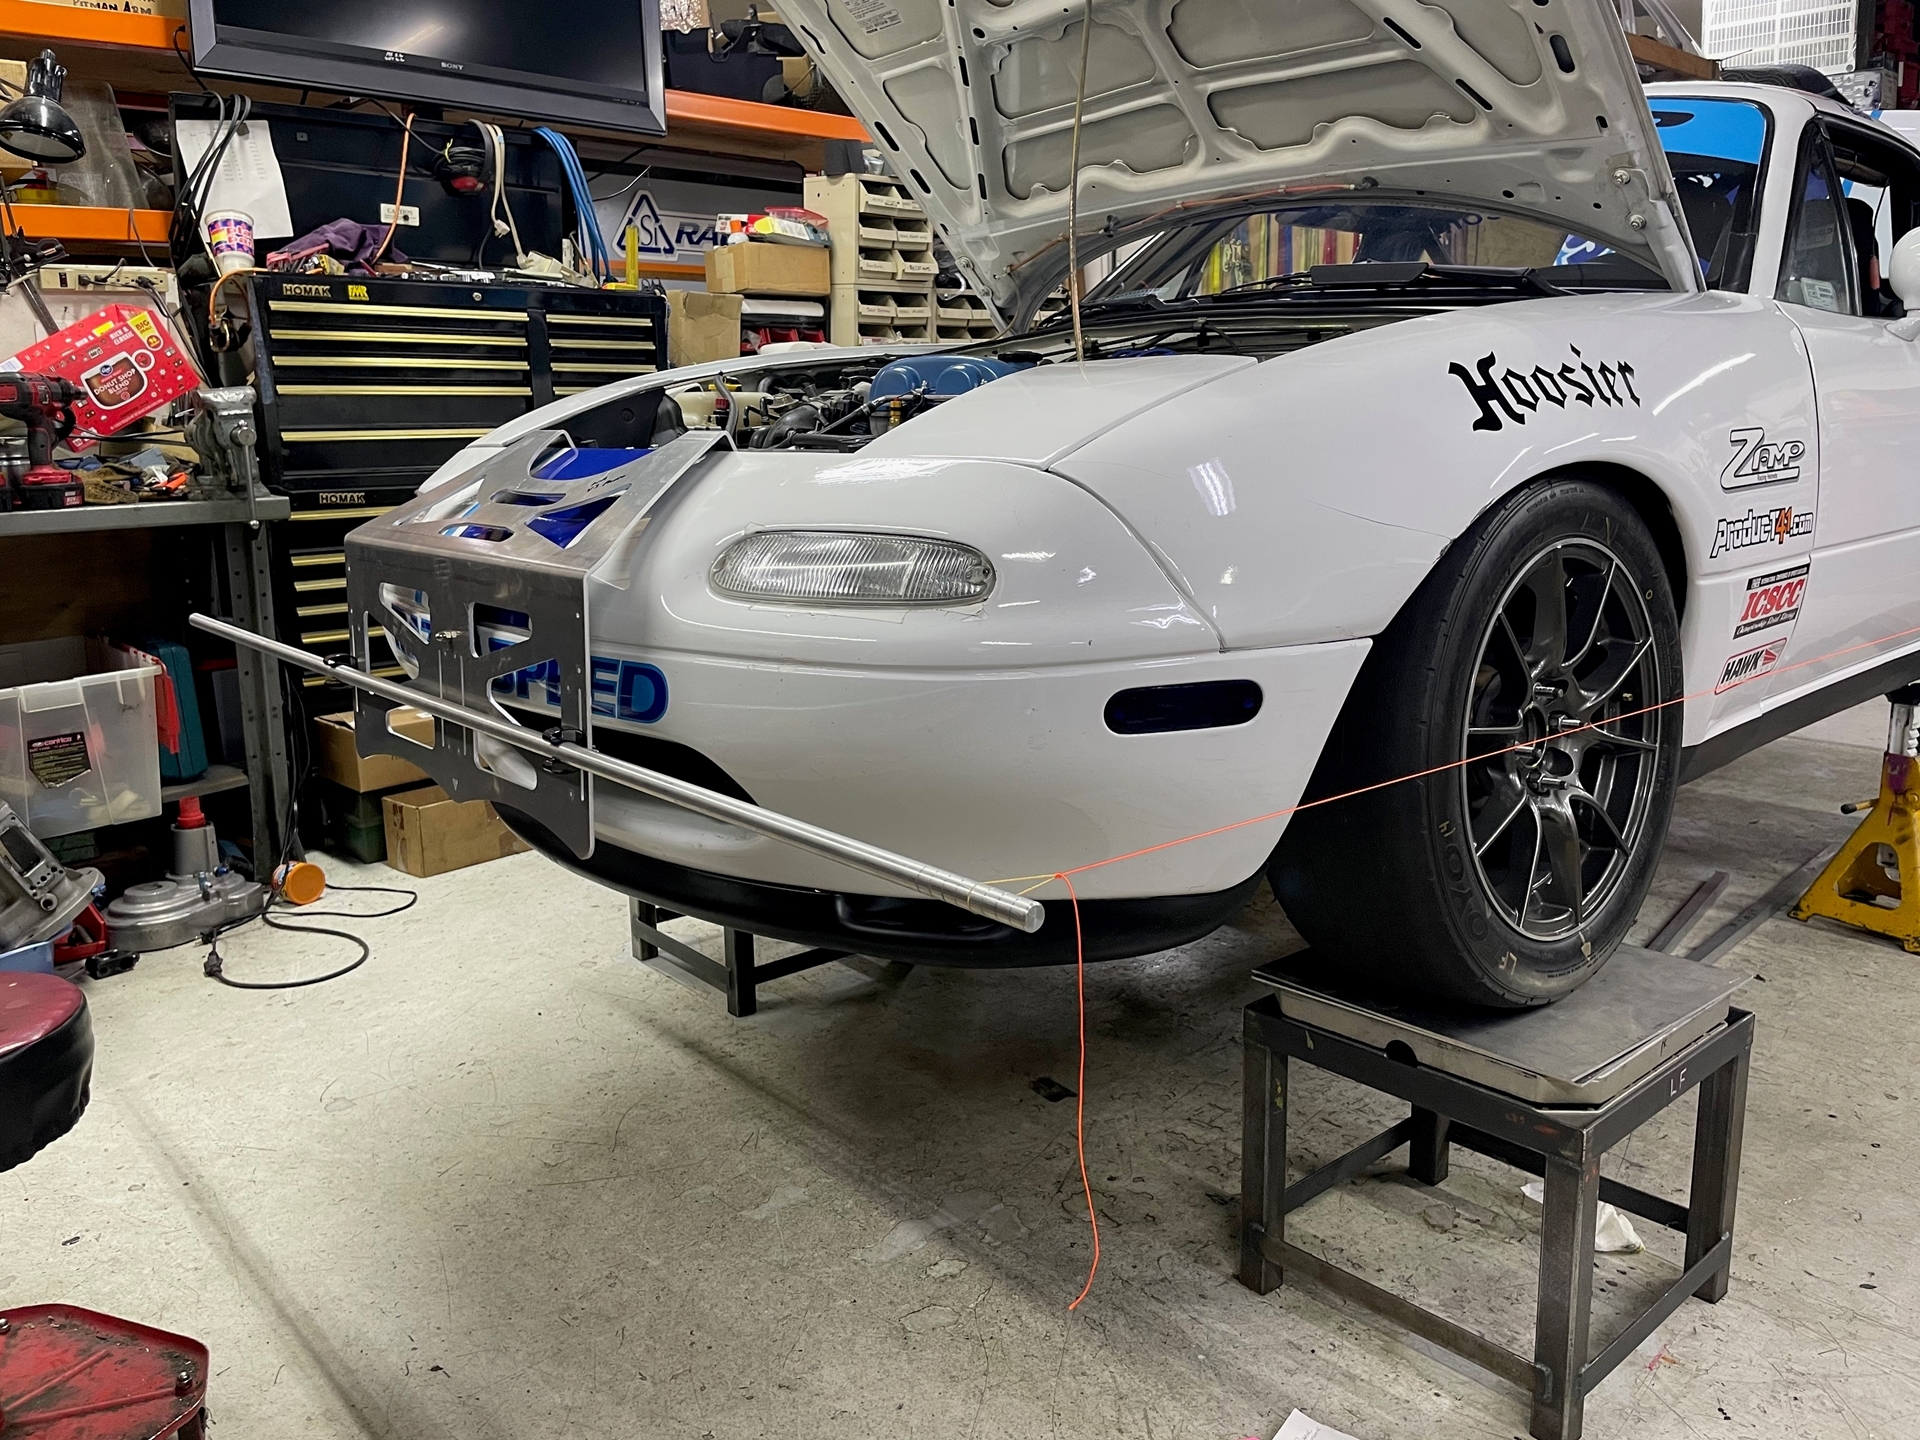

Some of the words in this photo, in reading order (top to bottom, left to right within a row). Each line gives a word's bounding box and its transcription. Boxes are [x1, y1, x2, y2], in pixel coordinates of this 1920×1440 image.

[73, 0, 118, 11] PITMAN
[123, 1, 152, 15] ARM
[441, 62, 464, 70] SONY
[282, 284, 331, 297] HOMAK
[135, 320, 150, 331] BIG
[94, 378, 118, 395] DONUT
[118, 368, 136, 382] SHOP
[1448, 343, 1641, 432] Hoosier
[319, 492, 366, 504] HOMAK
[1740, 578, 1805, 622] ICSCC
[1720, 649, 1765, 684] HAWK
[1670, 1067, 1687, 1097] LF
